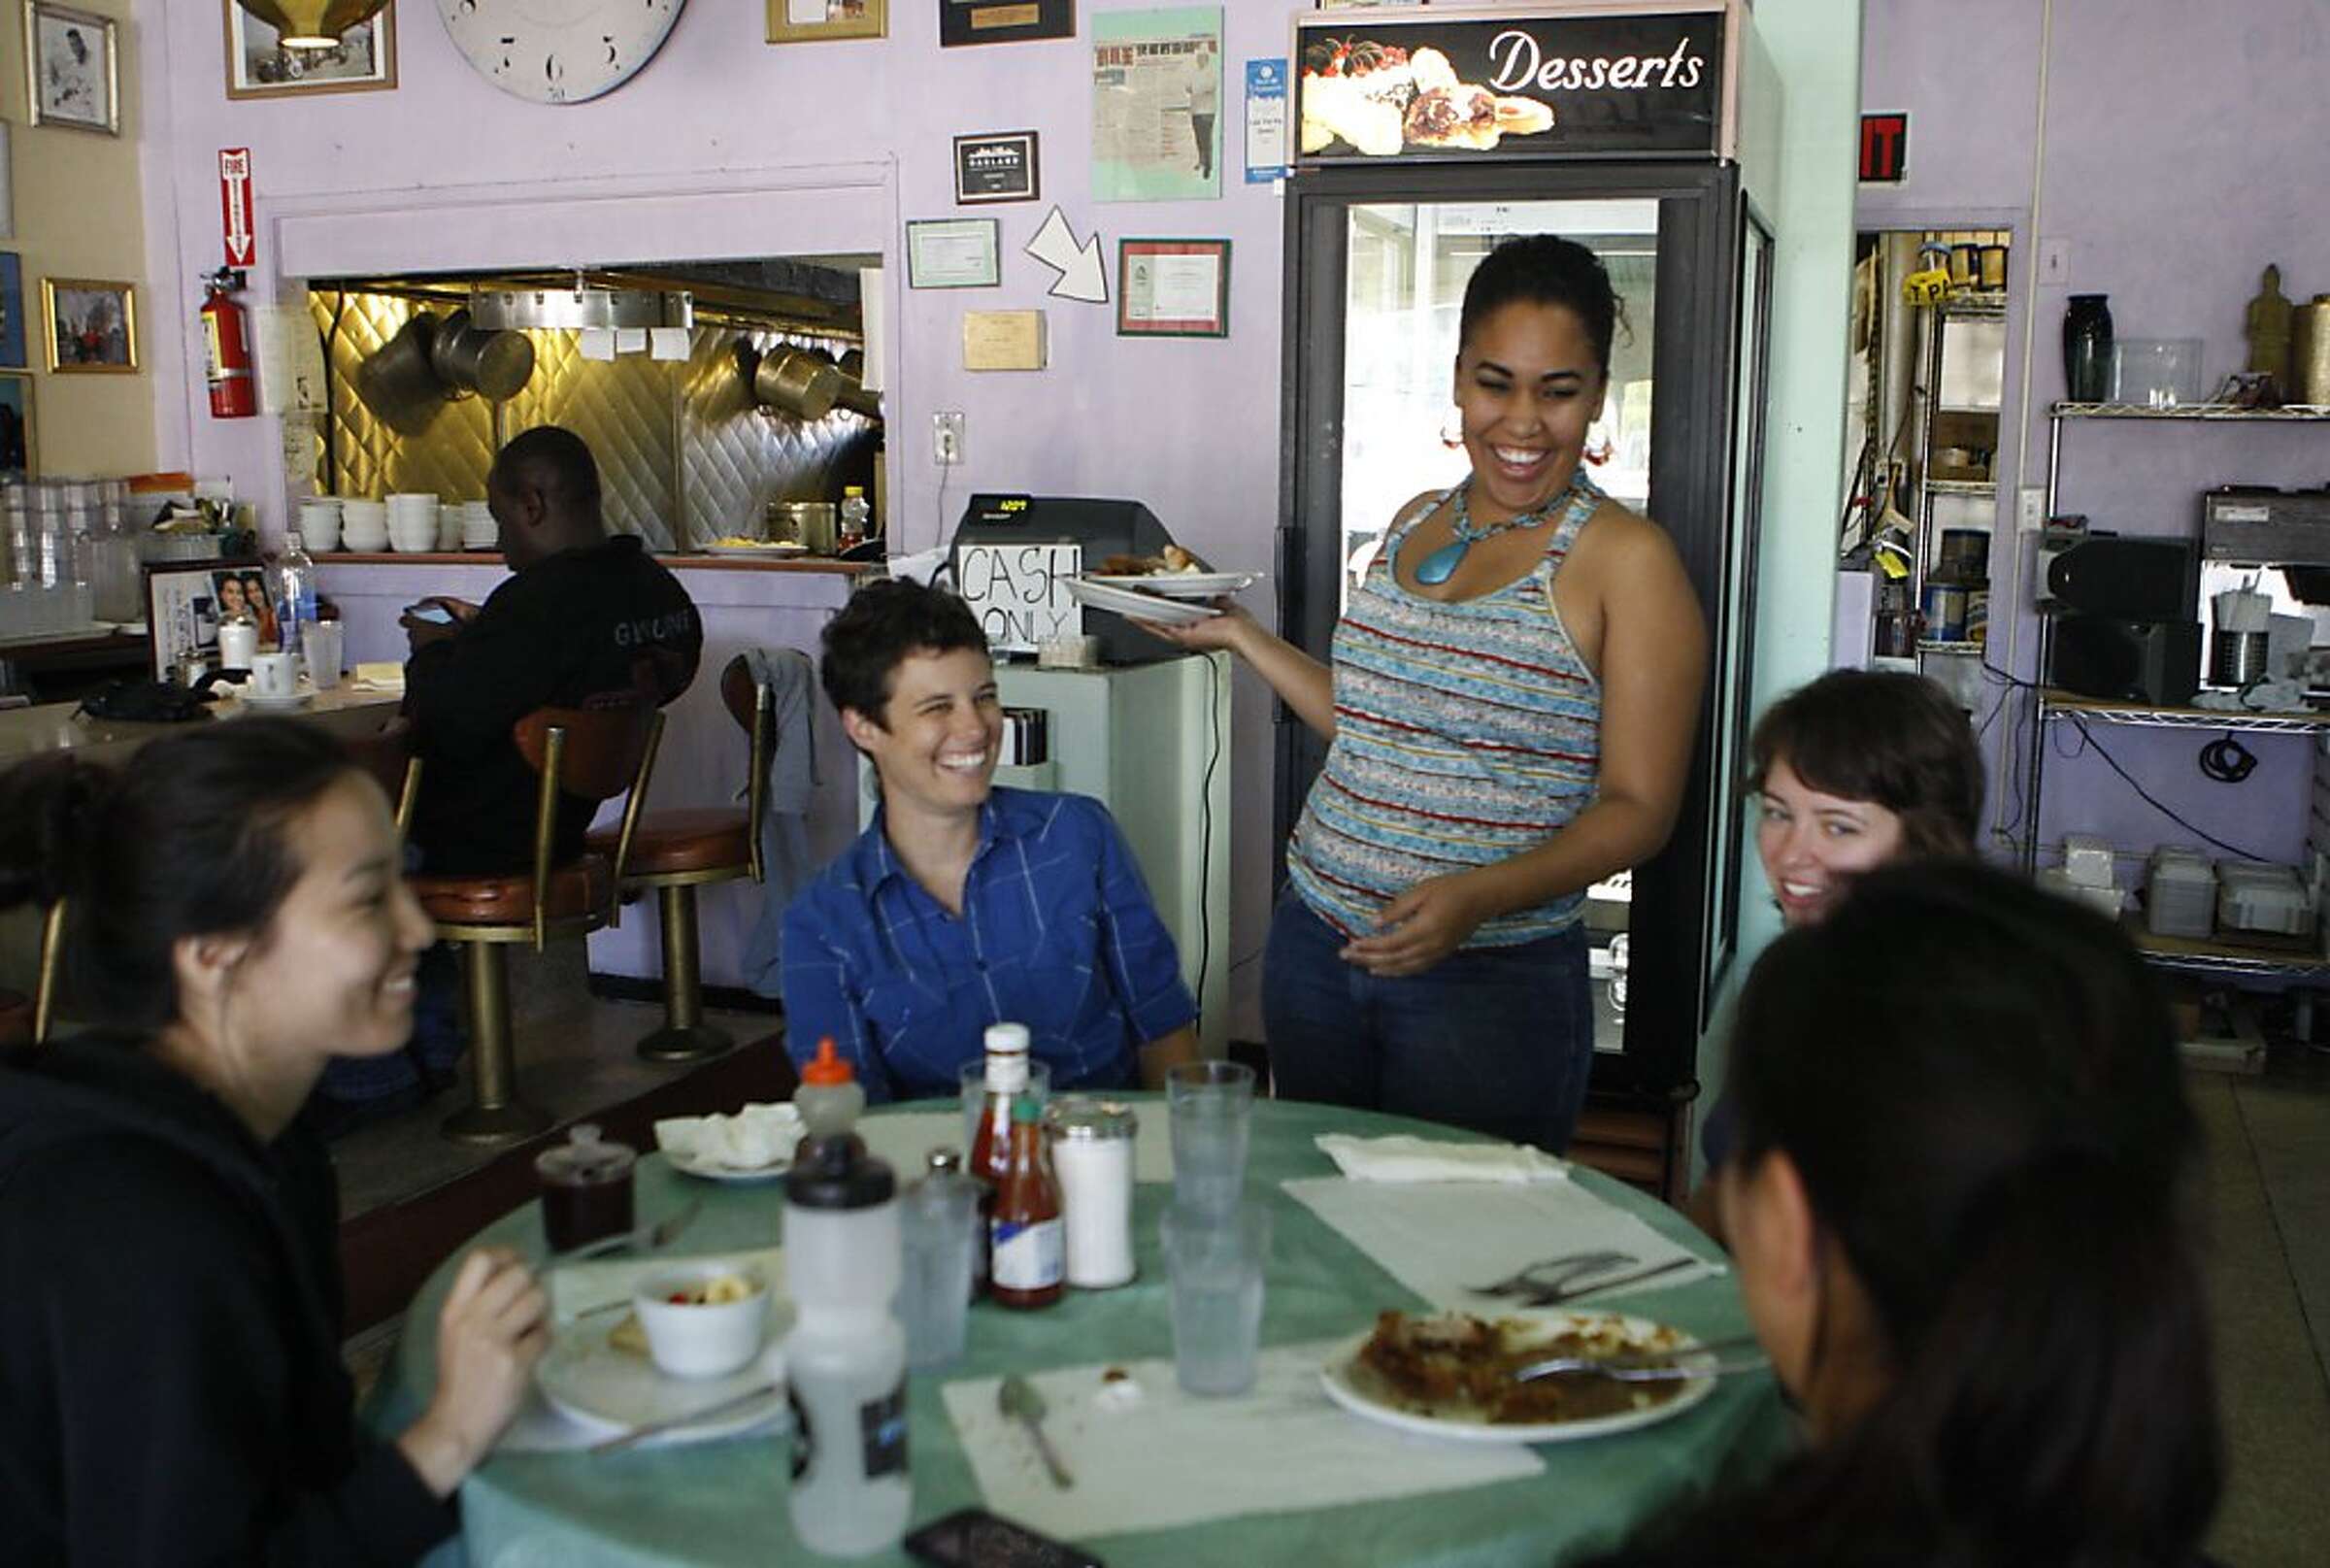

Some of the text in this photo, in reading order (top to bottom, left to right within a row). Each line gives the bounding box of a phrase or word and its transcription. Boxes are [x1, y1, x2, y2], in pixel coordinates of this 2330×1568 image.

[1489, 30, 1704, 91] Desserts
[1861, 117, 1904, 179] IT
[962, 547, 1079, 608] CASH
[982, 606, 1069, 645] ONLY
